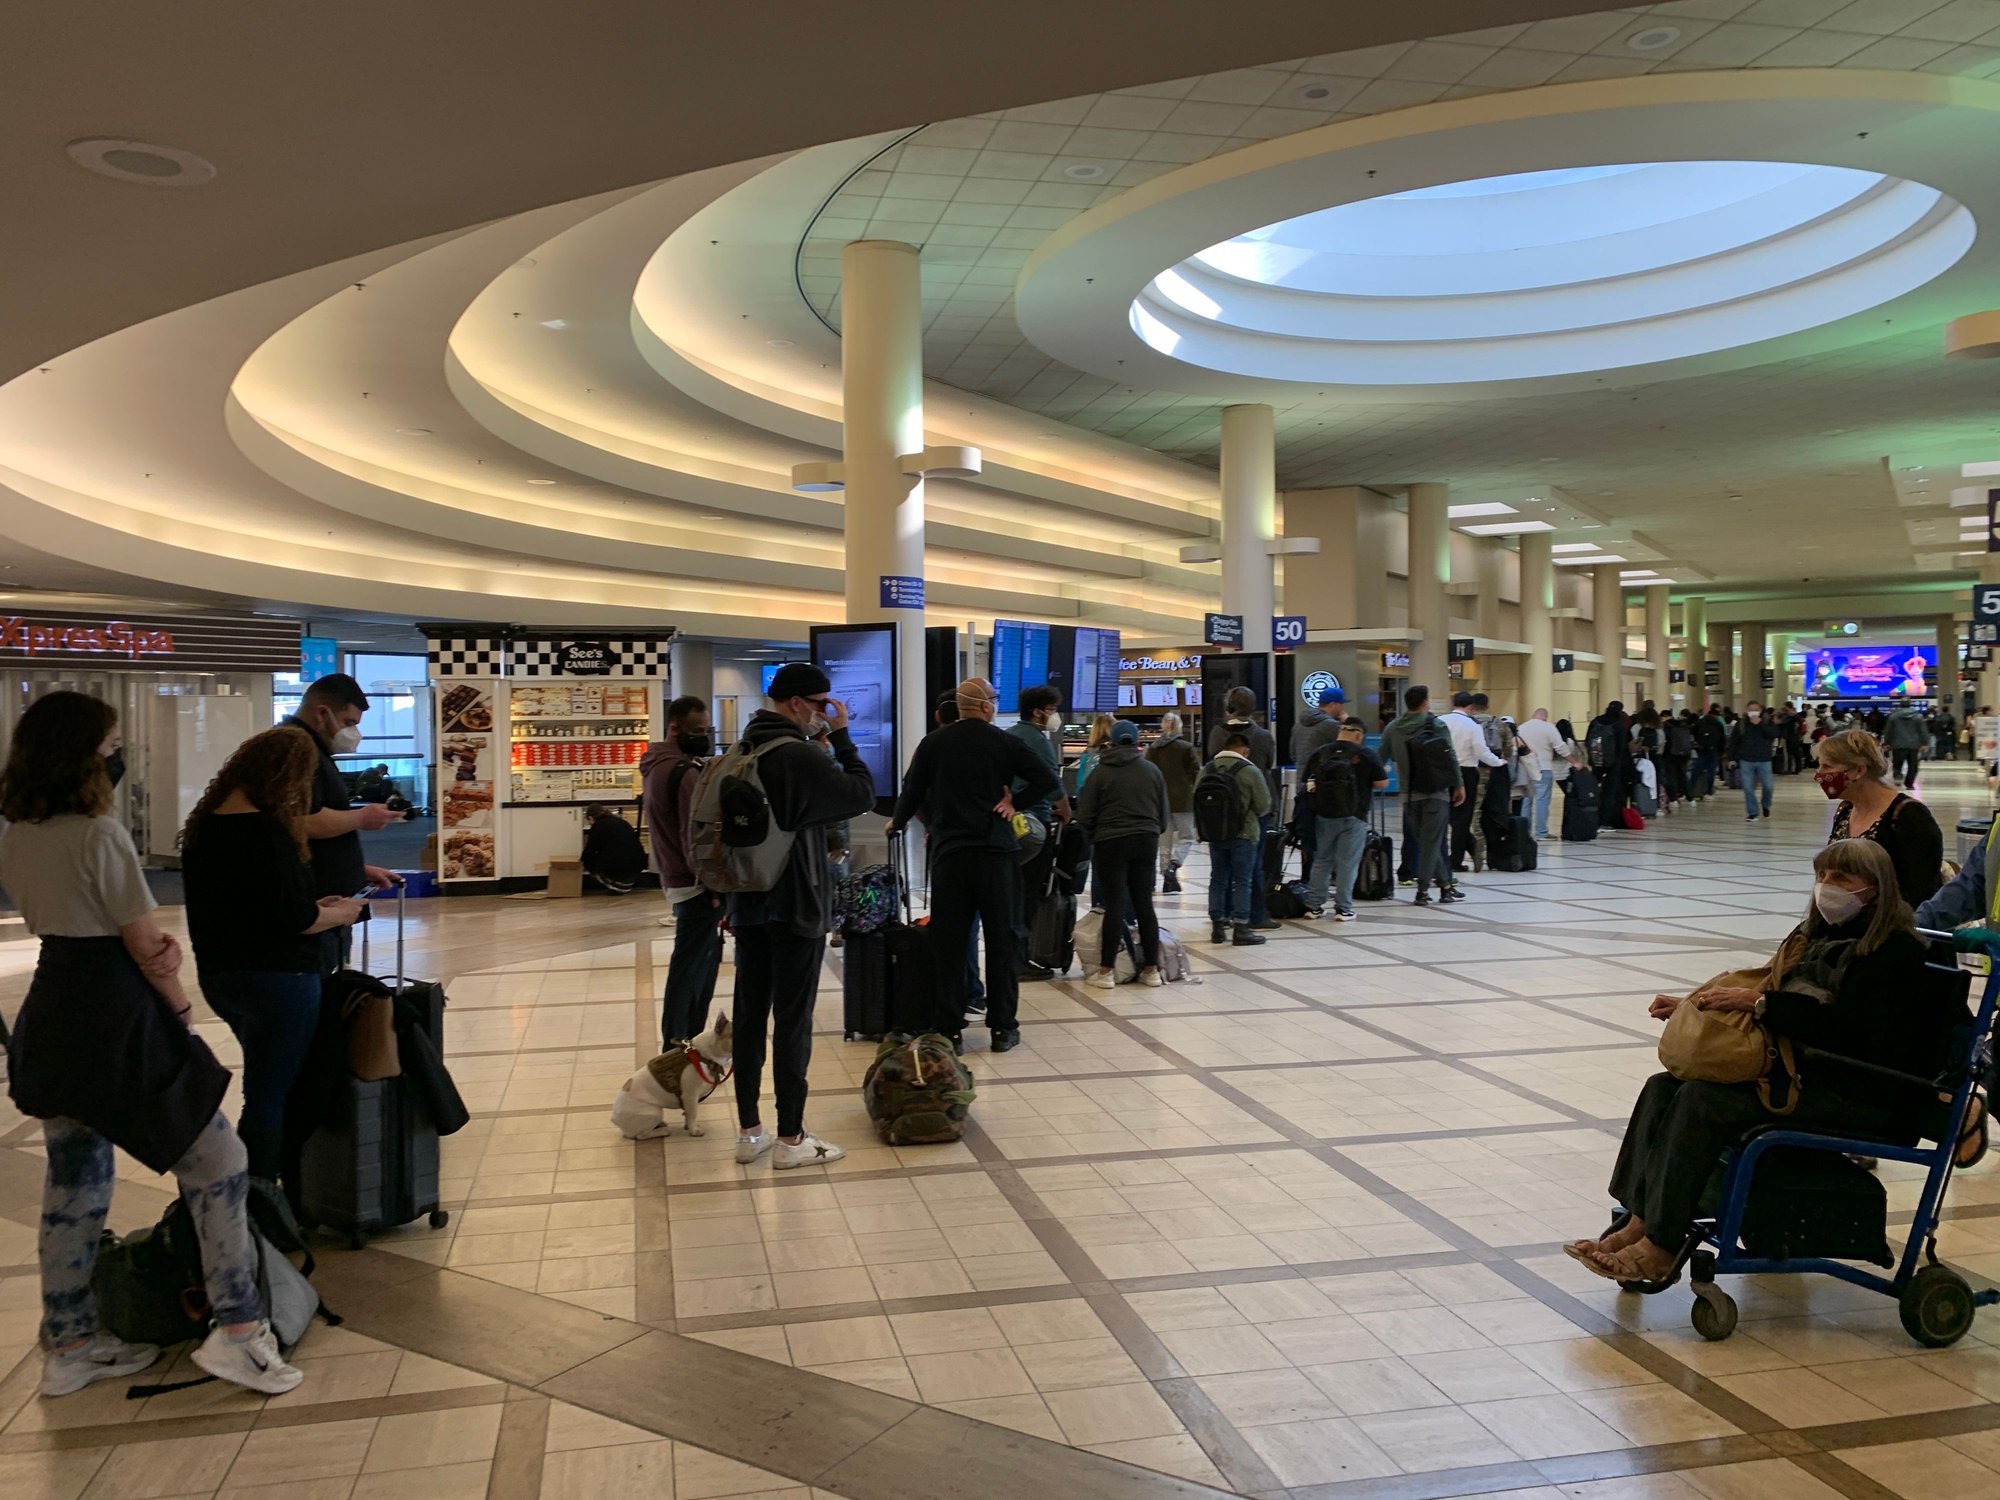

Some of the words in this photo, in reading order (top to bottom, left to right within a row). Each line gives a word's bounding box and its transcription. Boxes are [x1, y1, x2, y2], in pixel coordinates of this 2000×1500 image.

[0, 615, 175, 659] XpresSpa
[1276, 621, 1302, 641] 50
[569, 647, 604, 659] See's
[1137, 656, 1178, 671] Bean
[1177, 655, 1191, 669] &
